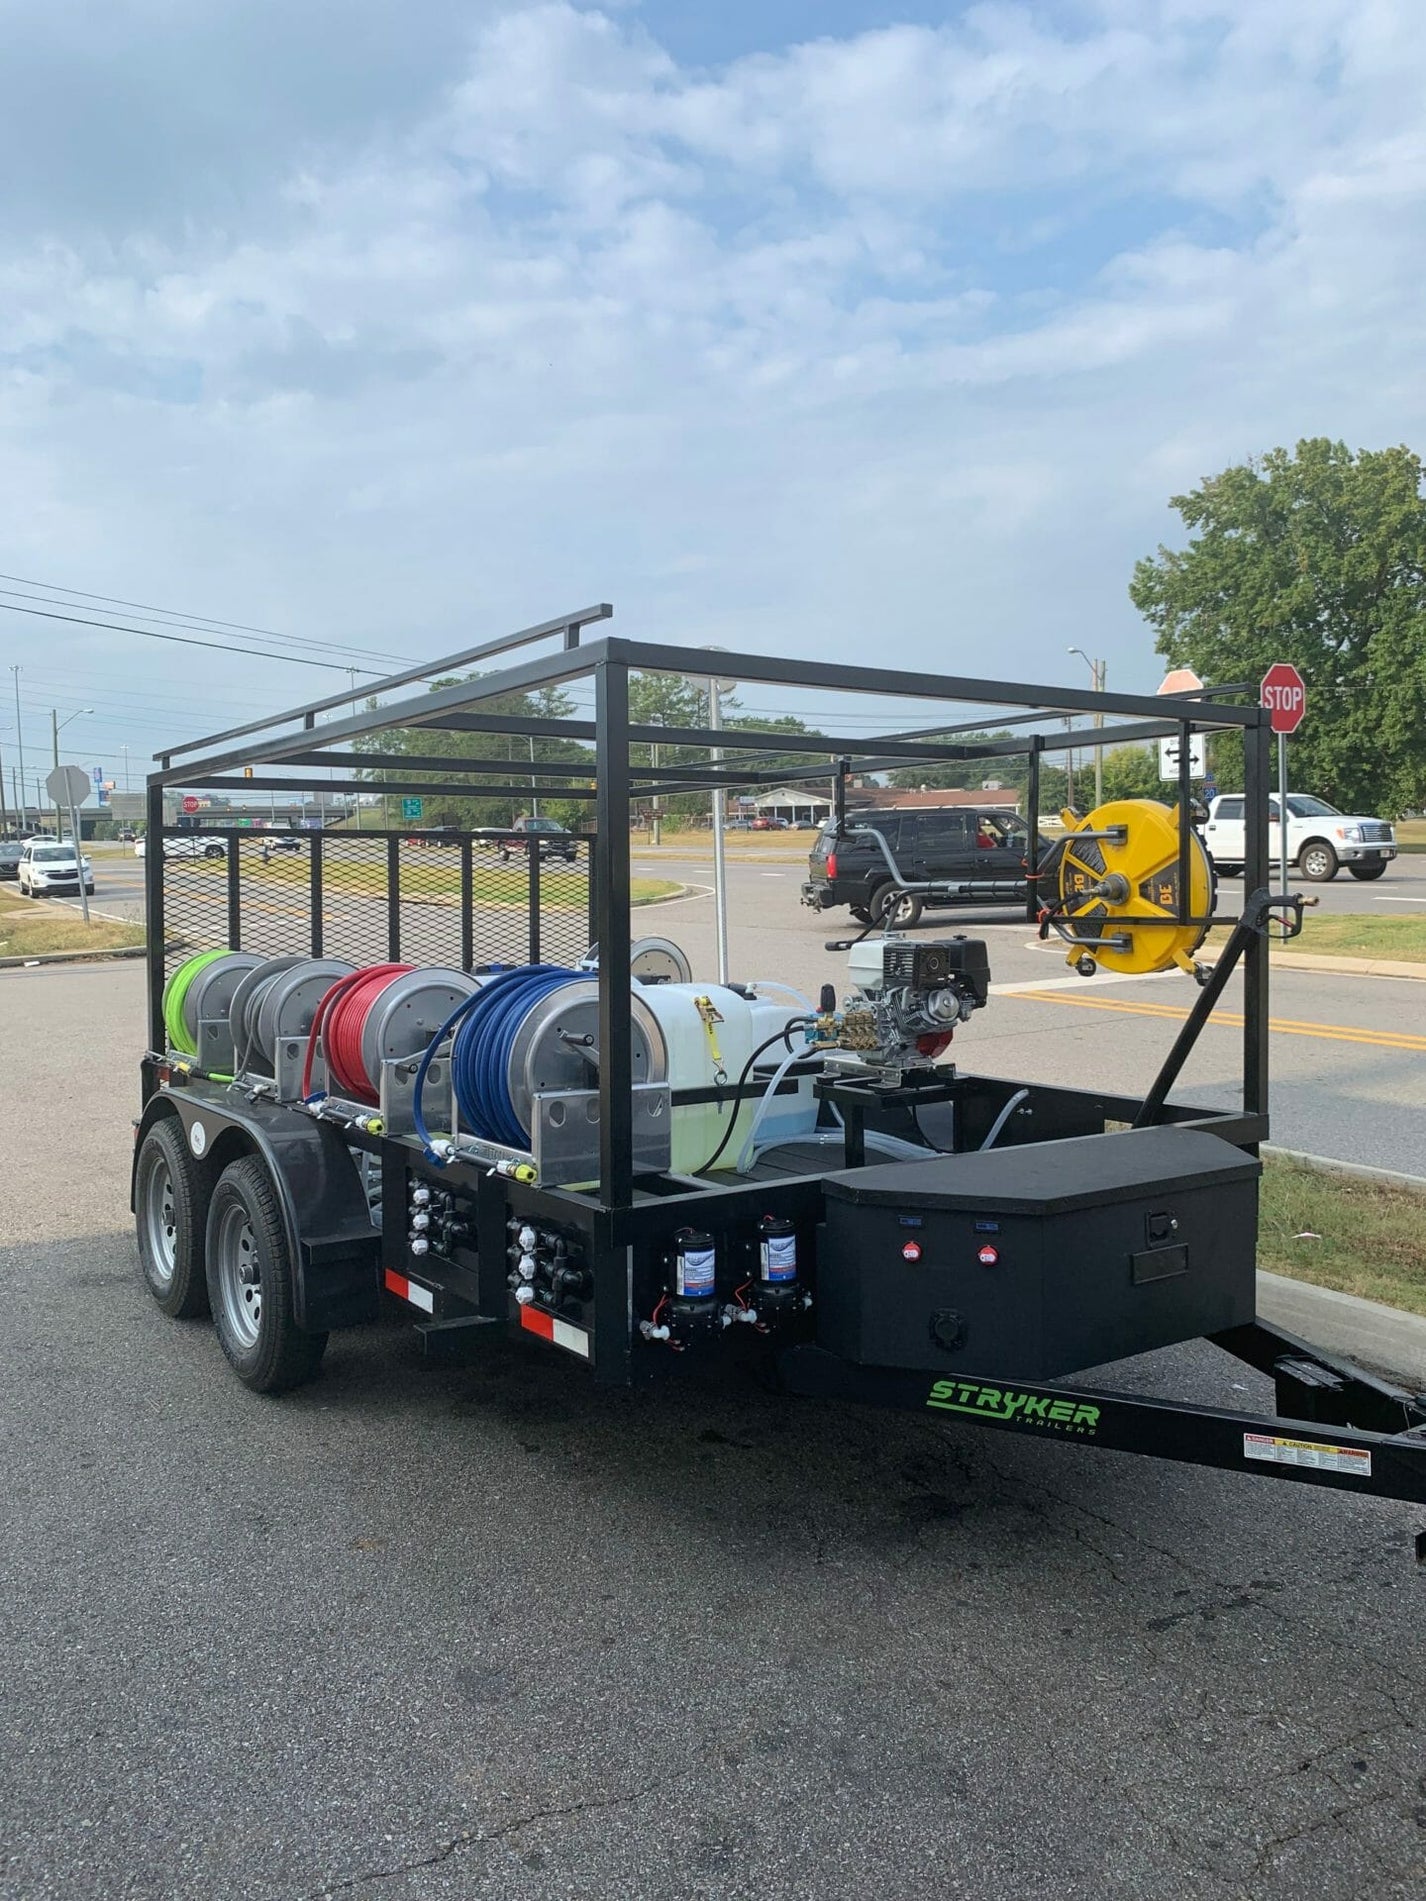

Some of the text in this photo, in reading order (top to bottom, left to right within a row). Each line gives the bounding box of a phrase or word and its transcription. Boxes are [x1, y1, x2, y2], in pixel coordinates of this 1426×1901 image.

[1264, 685, 1302, 711] STOP
[1204, 788, 1215, 800] 20
[1159, 884, 1173, 905] BE
[926, 1380, 1100, 1426] STRYKER
[1016, 1415, 1097, 1436] TRAILERS
[1288, 1440, 1313, 1450] CAUTION
